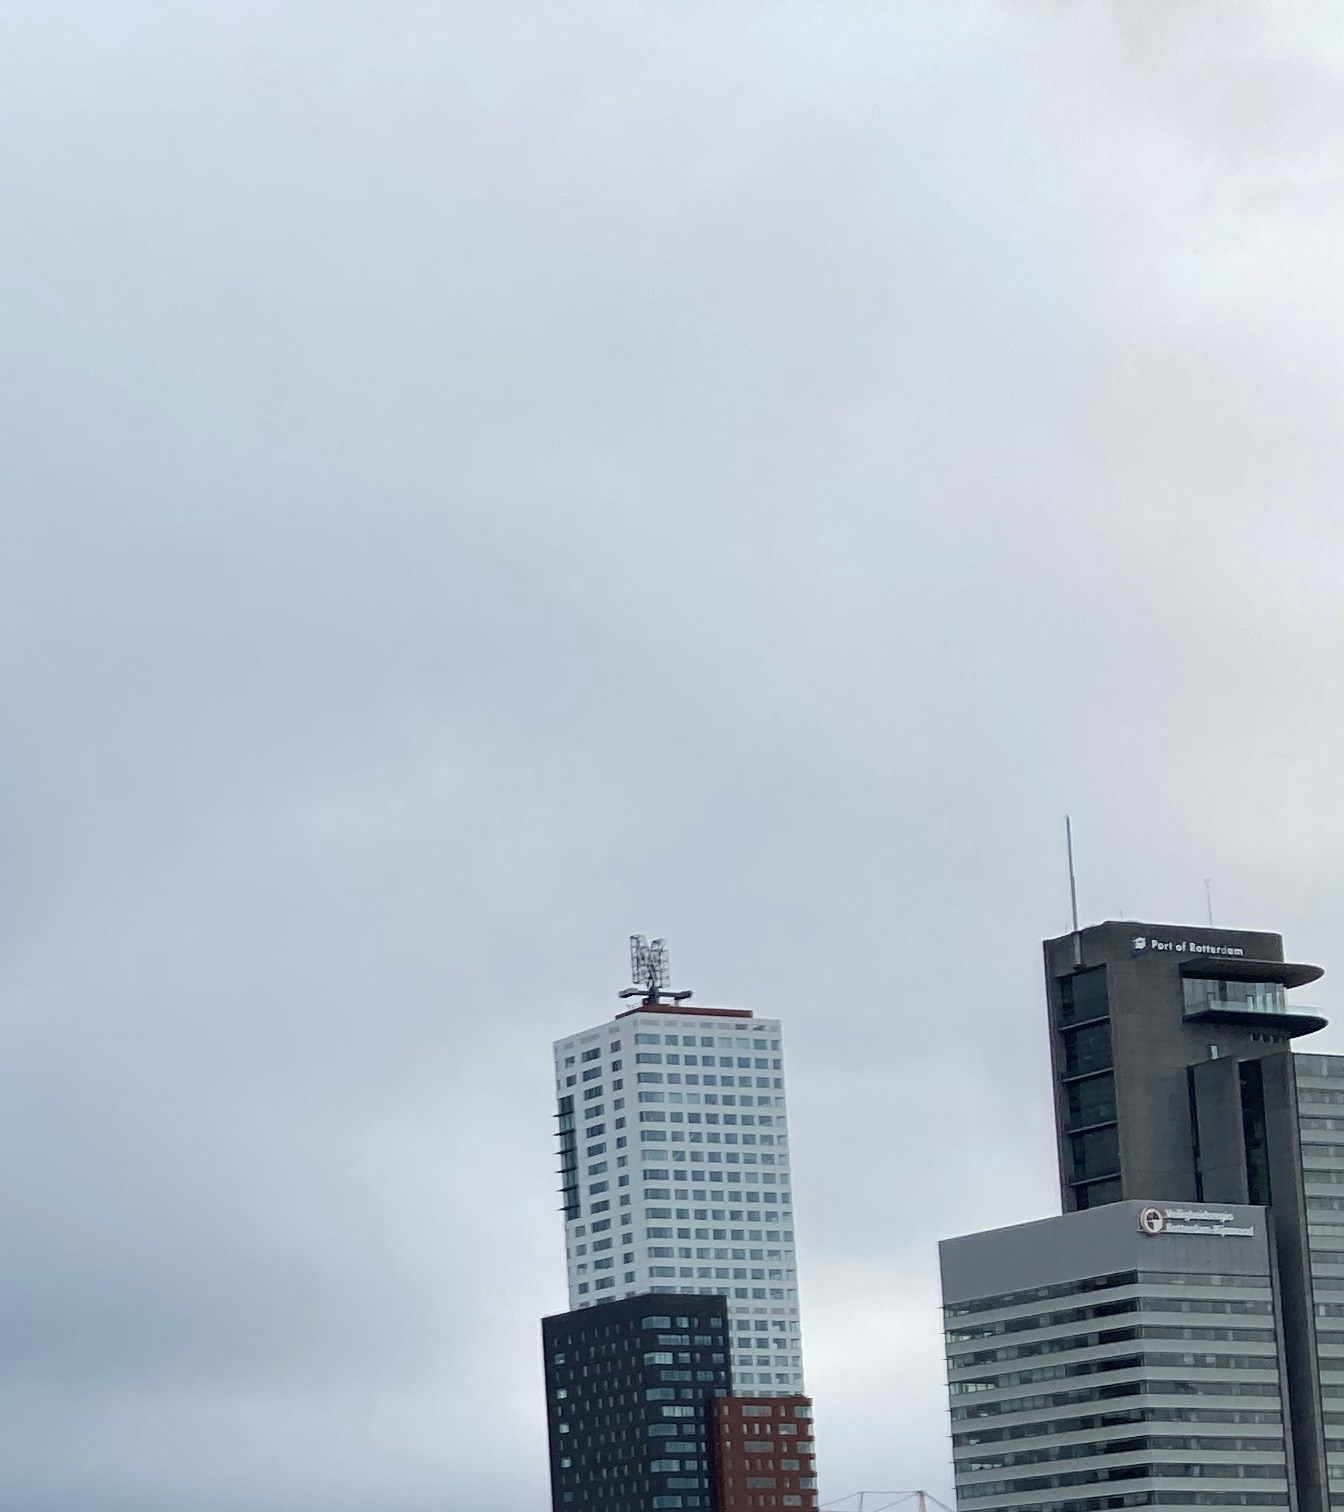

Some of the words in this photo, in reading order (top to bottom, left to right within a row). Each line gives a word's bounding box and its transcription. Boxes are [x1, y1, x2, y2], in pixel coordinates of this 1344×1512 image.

[1151, 939, 1173, 950] Port
[1175, 941, 1187, 952] of
[1189, 942, 1244, 956] Rotterdam
